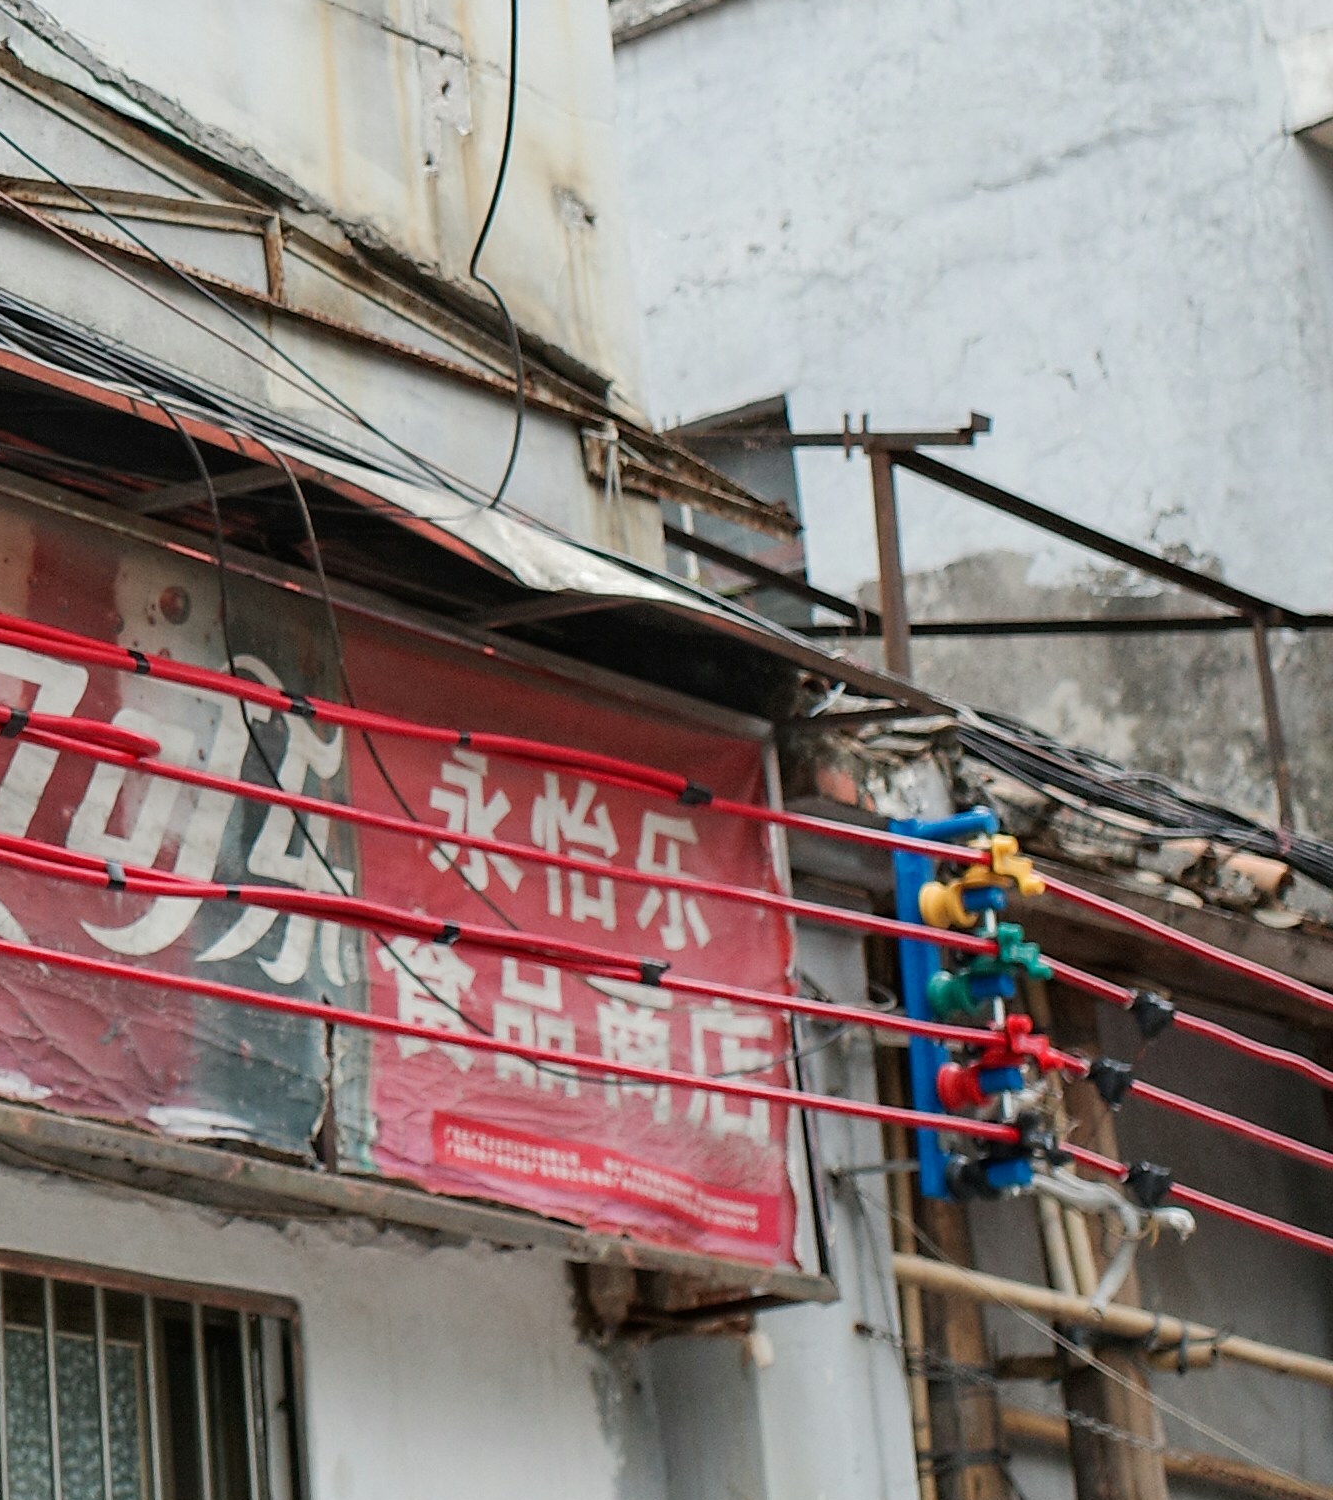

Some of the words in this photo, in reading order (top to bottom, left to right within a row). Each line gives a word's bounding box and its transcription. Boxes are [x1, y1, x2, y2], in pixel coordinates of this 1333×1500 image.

[429, 748, 712, 951] 永怡乐
[377, 910, 775, 1148] 食品商店
